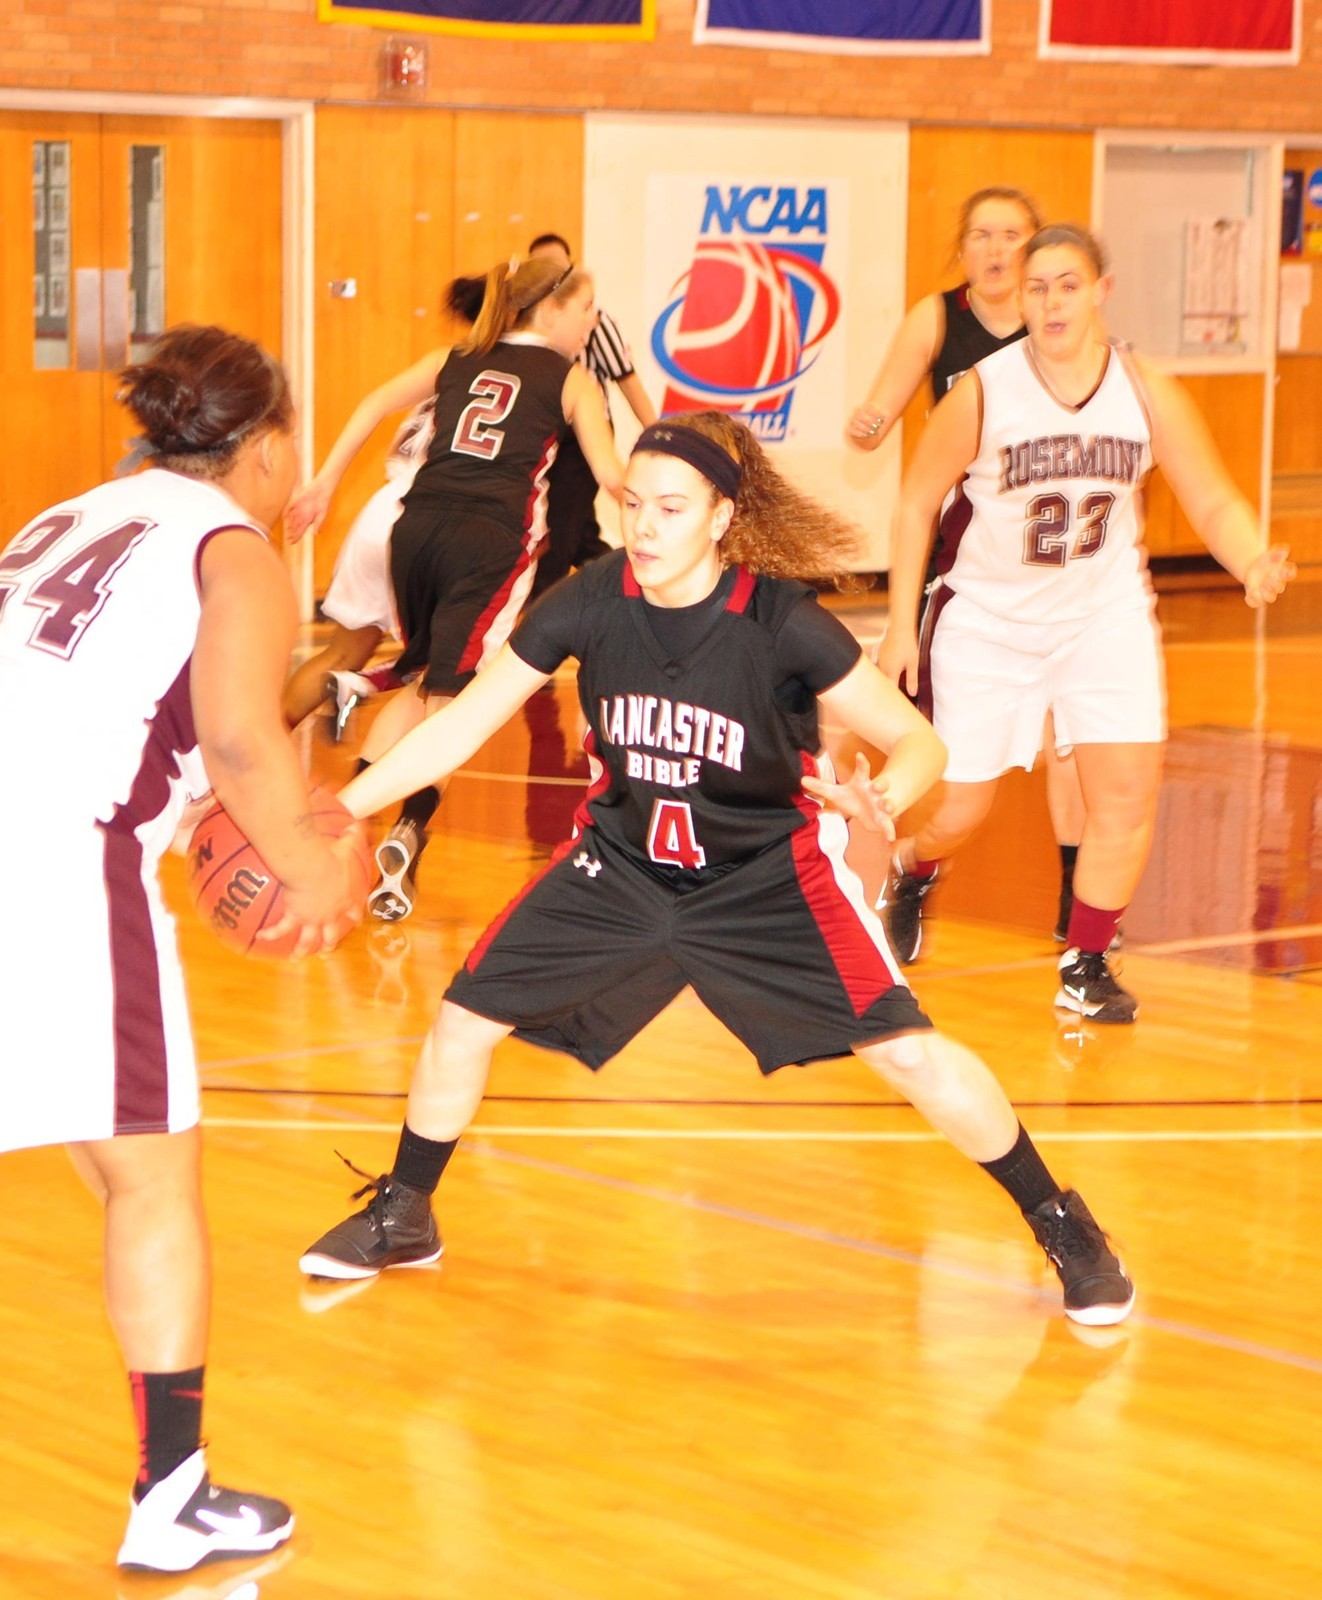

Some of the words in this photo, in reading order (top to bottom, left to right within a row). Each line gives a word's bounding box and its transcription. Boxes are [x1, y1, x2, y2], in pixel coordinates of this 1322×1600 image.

[700, 186, 827, 235] NCAA
[451, 369, 522, 461] 2
[1021, 491, 1116, 568] 23
[0, 510, 160, 662] 24
[626, 750, 702, 788] BIBLE
[646, 798, 707, 870] 4
